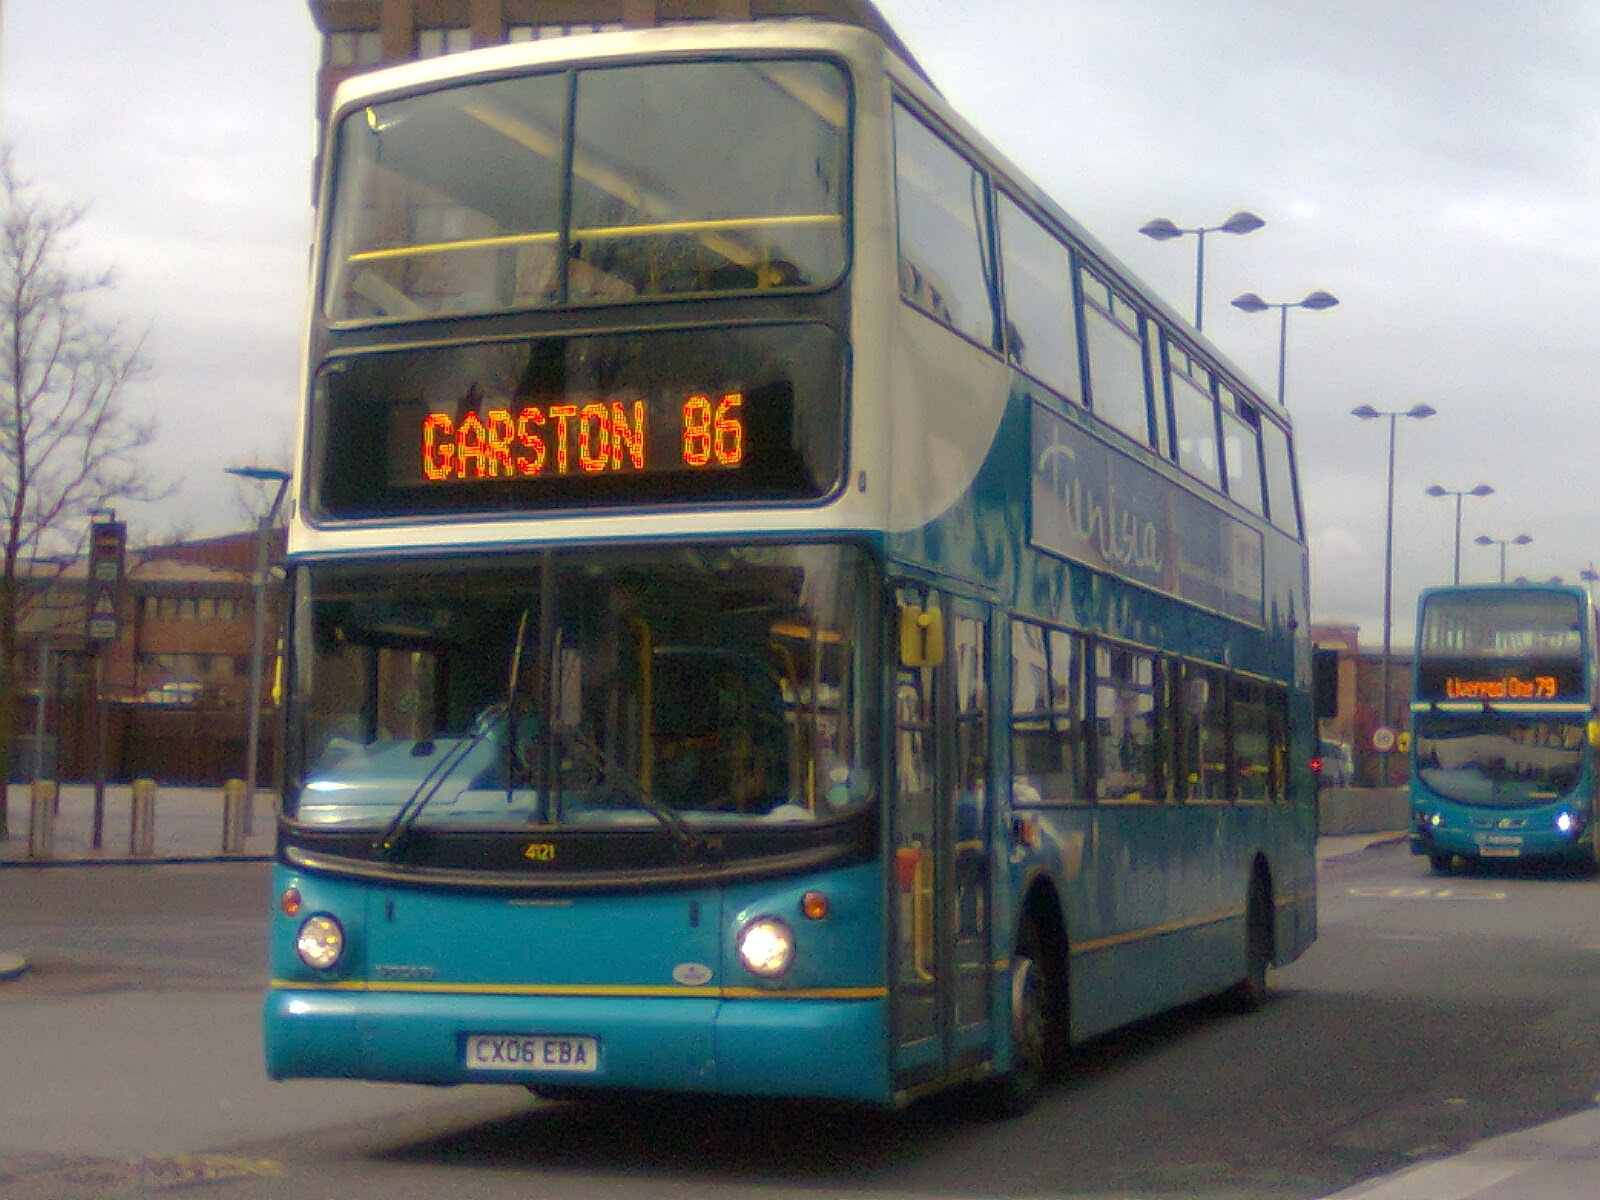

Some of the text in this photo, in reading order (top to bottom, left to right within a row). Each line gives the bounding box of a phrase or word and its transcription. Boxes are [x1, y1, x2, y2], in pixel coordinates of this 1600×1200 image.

[422, 393, 744, 481] GARSTON 86
[1534, 675, 1557, 698] 79
[476, 1038, 587, 1065] CX06 EBA
